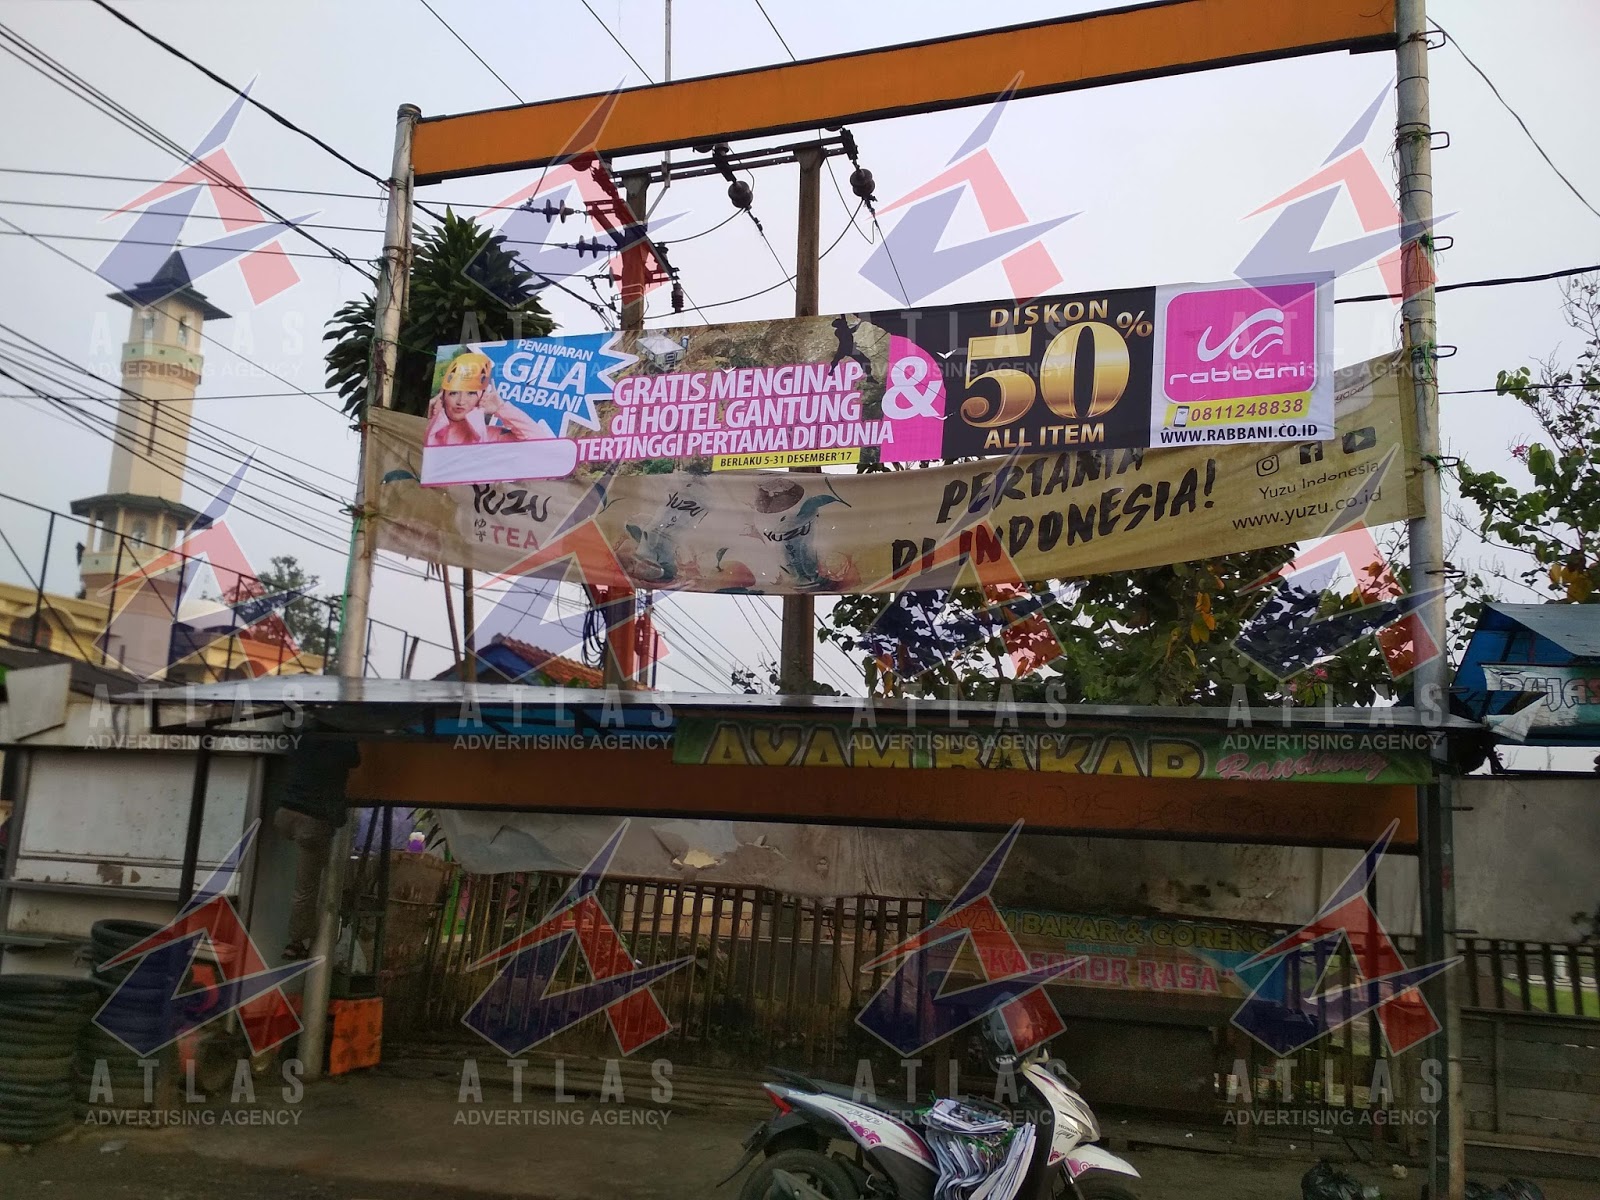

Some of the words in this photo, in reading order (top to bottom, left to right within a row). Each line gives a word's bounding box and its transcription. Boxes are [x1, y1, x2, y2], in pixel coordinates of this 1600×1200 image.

[989, 299, 1108, 328] DISKON
[516, 339, 594, 361] PENAWARAN
[503, 353, 588, 396] GILA
[614, 373, 706, 407] GRATIS
[711, 362, 864, 400] MENGINAP
[881, 357, 945, 419] &
[1168, 361, 1306, 385] rabbani
[500, 383, 585, 413] RABBANI
[612, 404, 637, 435] di
[641, 401, 722, 434] HOTEL
[726, 392, 861, 427] GANTUNG
[1190, 398, 1304, 422] 0811248838
[578, 435, 684, 462] TERTINGGI
[687, 428, 788, 456] PERTAMA
[792, 425, 819, 449] DI
[824, 420, 894, 448] DUNIA
[984, 425, 1032, 449] ALL
[1036, 423, 1105, 447] ITEM
[1160, 422, 1318, 444] WWW.RABBANI.CO.ID
[720, 456, 762, 468] BERLAKU
[763, 455, 785, 465] 5-31
[1258, 481, 1297, 502] Yuzu
[1302, 461, 1379, 489] Indonesia
[892, 537, 936, 580] DI
[959, 459, 1216, 567] INDONESIA!
[1232, 486, 1382, 531] www.yuzu.co.id
[490, 525, 540, 550] TEA
[936, 905, 1016, 933] AYAM
[1021, 915, 1120, 944] BAKAR
[1122, 921, 1148, 946] &
[1151, 924, 1276, 954] GORENG
